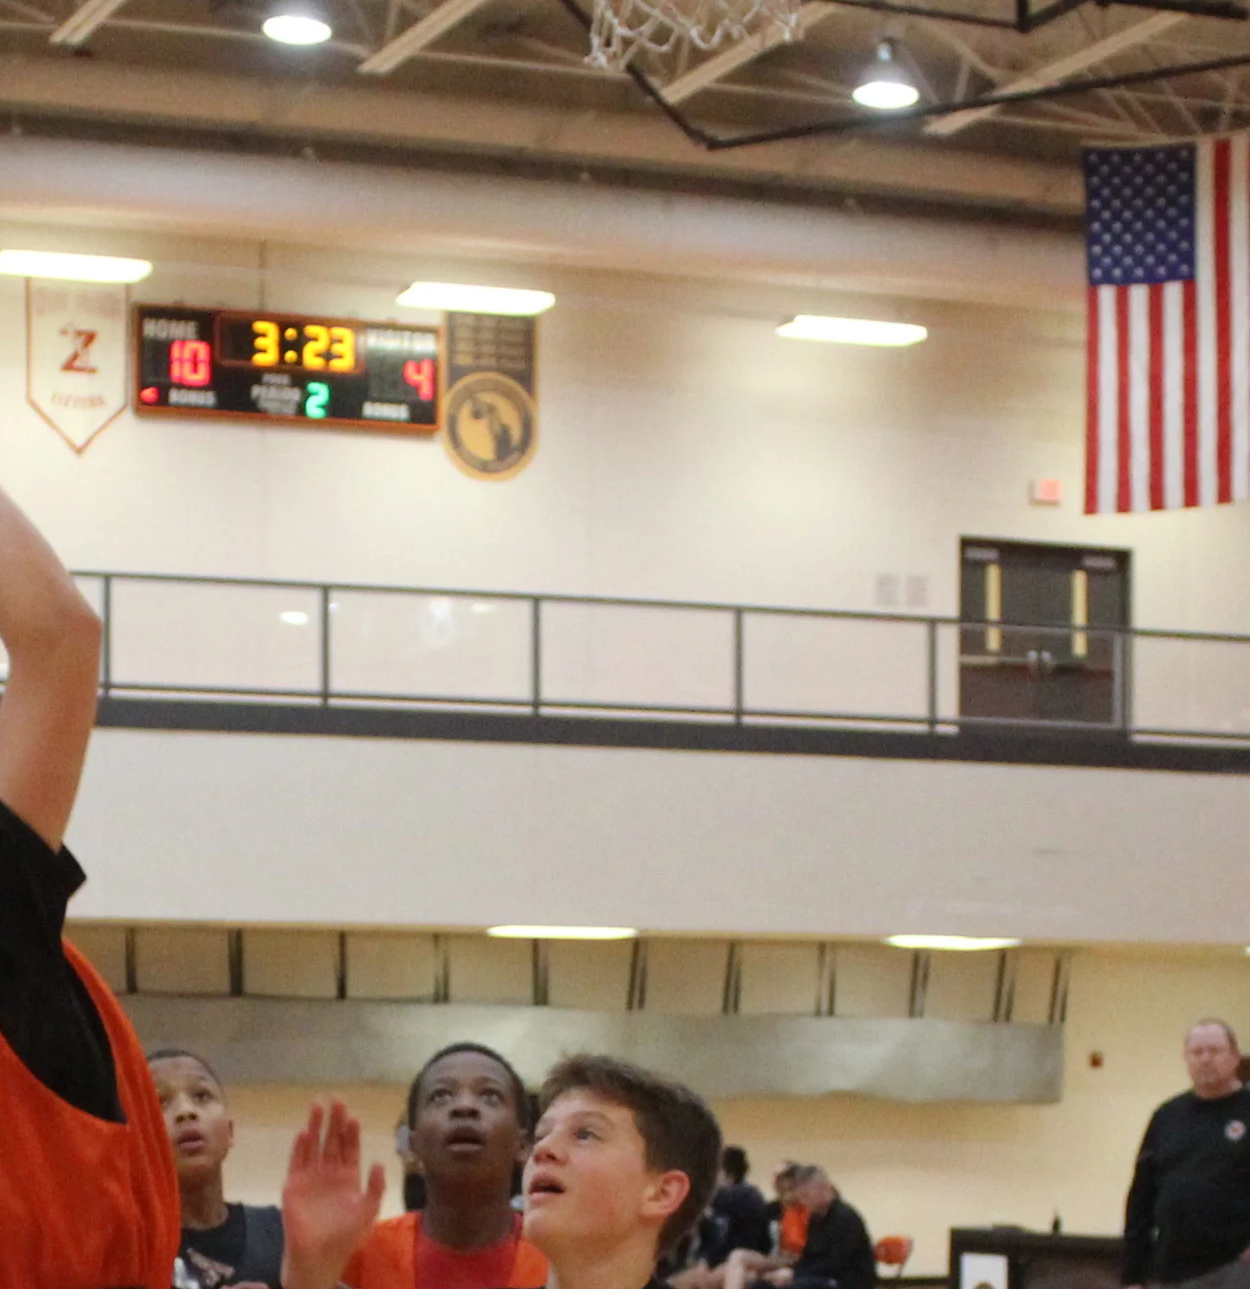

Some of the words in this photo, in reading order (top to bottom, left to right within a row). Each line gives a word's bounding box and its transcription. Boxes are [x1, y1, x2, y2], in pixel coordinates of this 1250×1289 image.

[142, 317, 198, 341] HOME
[251, 320, 356, 373] 3:23
[169, 339, 212, 388] 10
[403, 358, 435, 402] 4
[305, 381, 330, 420] 2
